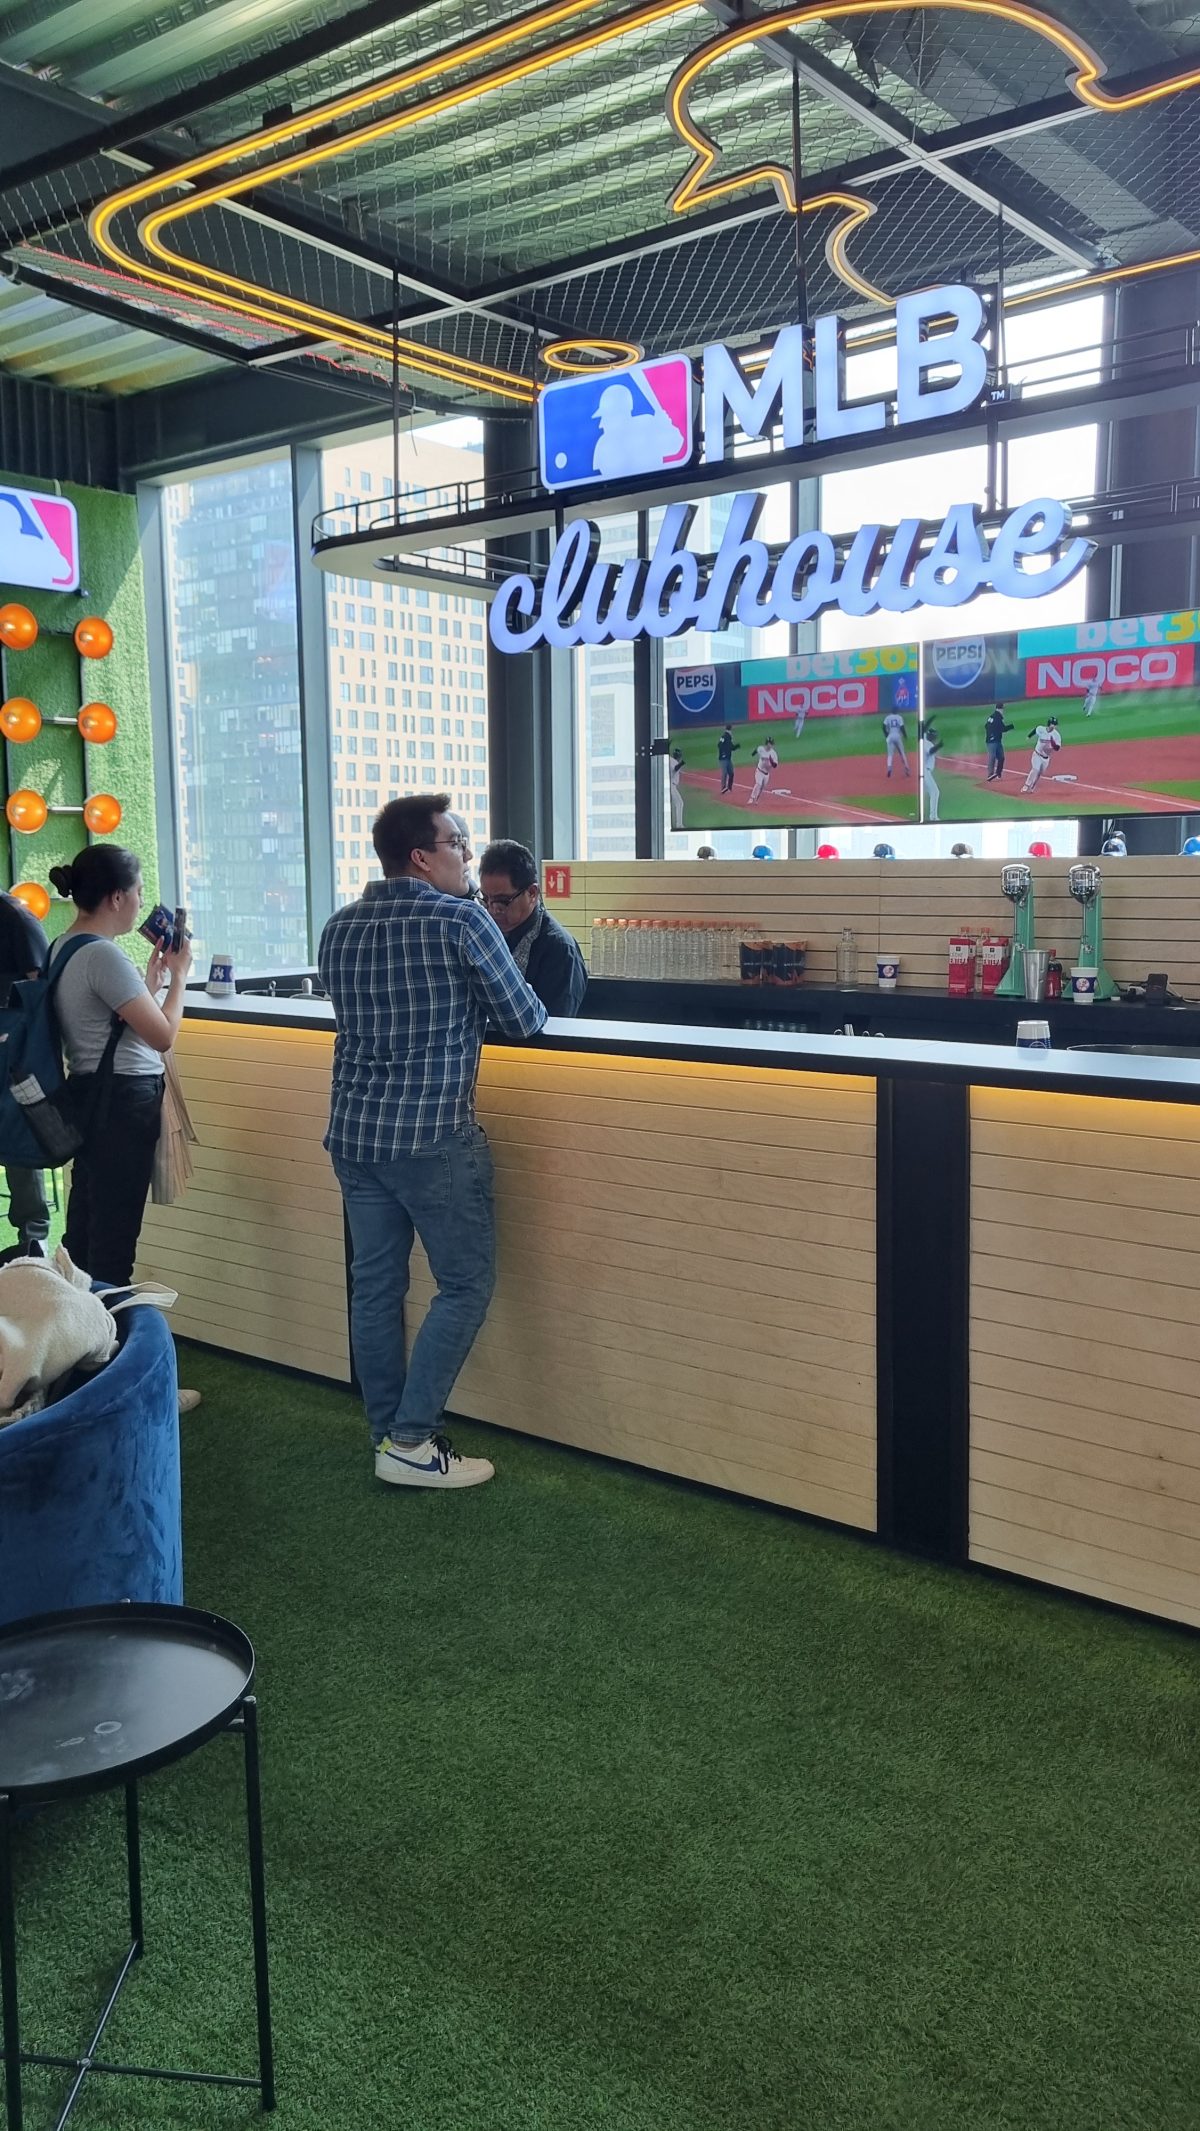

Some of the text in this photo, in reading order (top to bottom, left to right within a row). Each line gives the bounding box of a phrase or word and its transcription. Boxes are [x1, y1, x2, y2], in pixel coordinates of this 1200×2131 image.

[704, 284, 988, 463] MLB
[489, 492, 1099, 655] clubhouse
[1076, 610, 1200, 650] bet3
[936, 644, 983, 662] PEPSI
[1037, 651, 1177, 690] NOCO
[676, 673, 714, 689] PEPSI
[757, 682, 866, 715] NOCO
